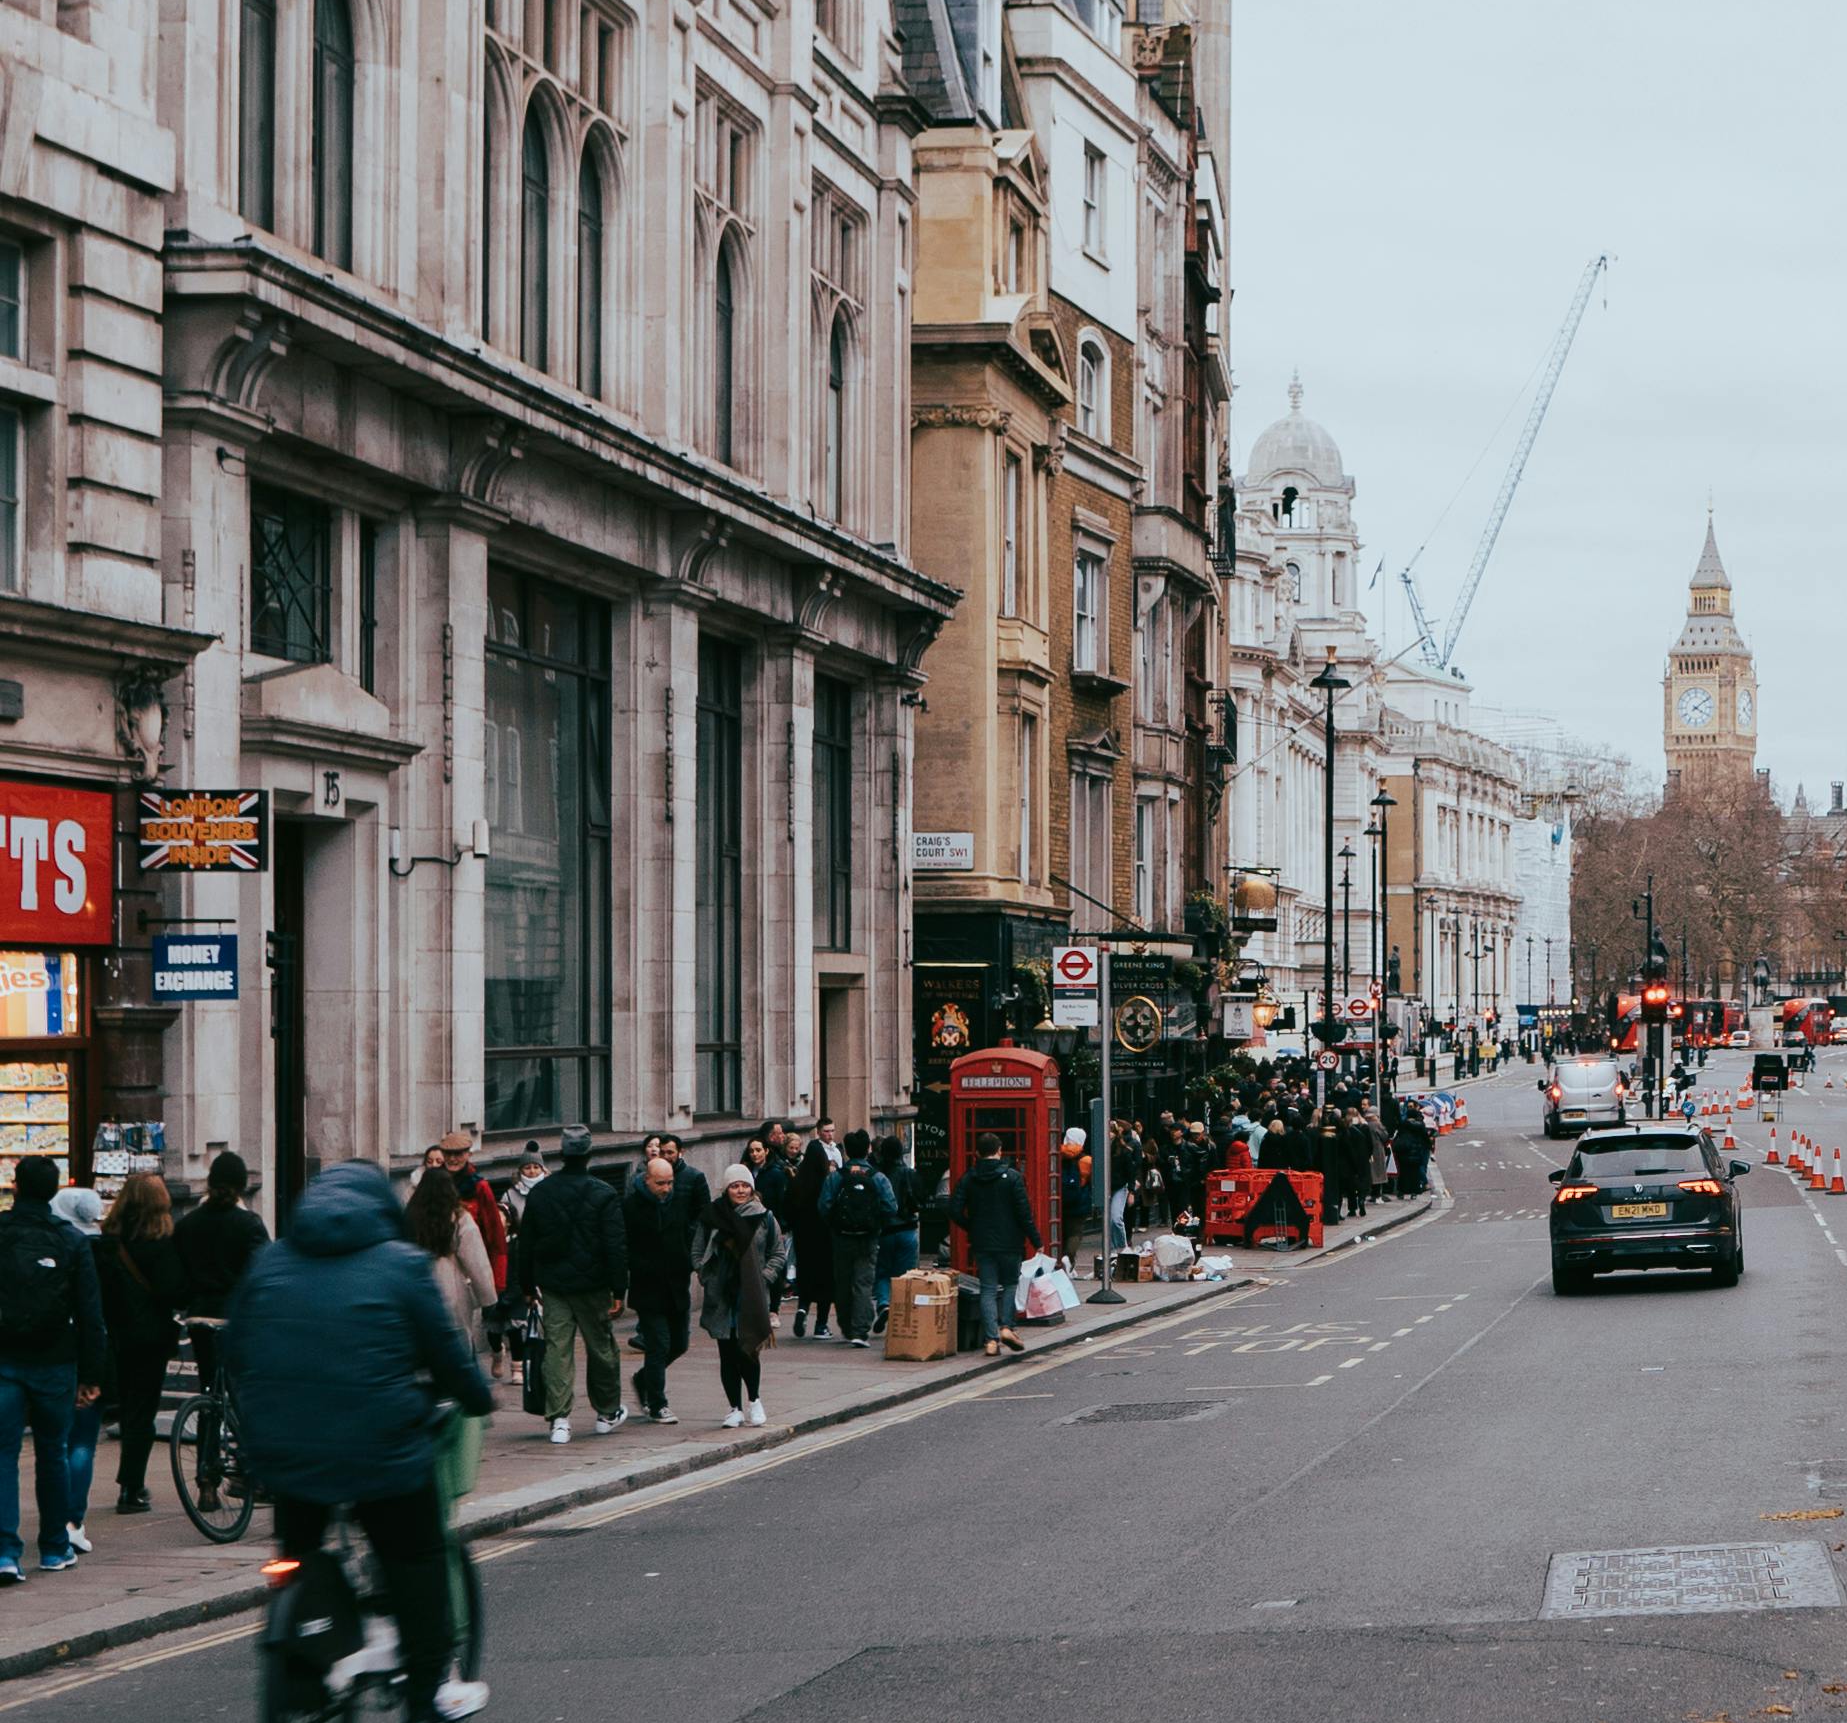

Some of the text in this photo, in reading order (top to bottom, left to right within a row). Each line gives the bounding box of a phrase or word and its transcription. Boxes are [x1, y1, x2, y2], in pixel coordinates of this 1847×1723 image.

[323, 771, 340, 807] 15
[159, 798, 241, 818] LONDON
[146, 821, 255, 841] SOUVENIRS
[916, 836, 951, 846] CRAIG'S
[168, 846, 232, 865] INSIDE
[916, 847, 968, 857] COURT SW1
[0, 815, 87, 914] TS
[167, 944, 221, 965] MONEY
[155, 971, 234, 991] EXCHANGE
[923, 979, 980, 989] WALKERS
[1322, 1056, 1335, 1064] 20
[963, 1076, 1030, 1087] TELEPHONE
[1175, 1321, 1372, 1341] BUS
